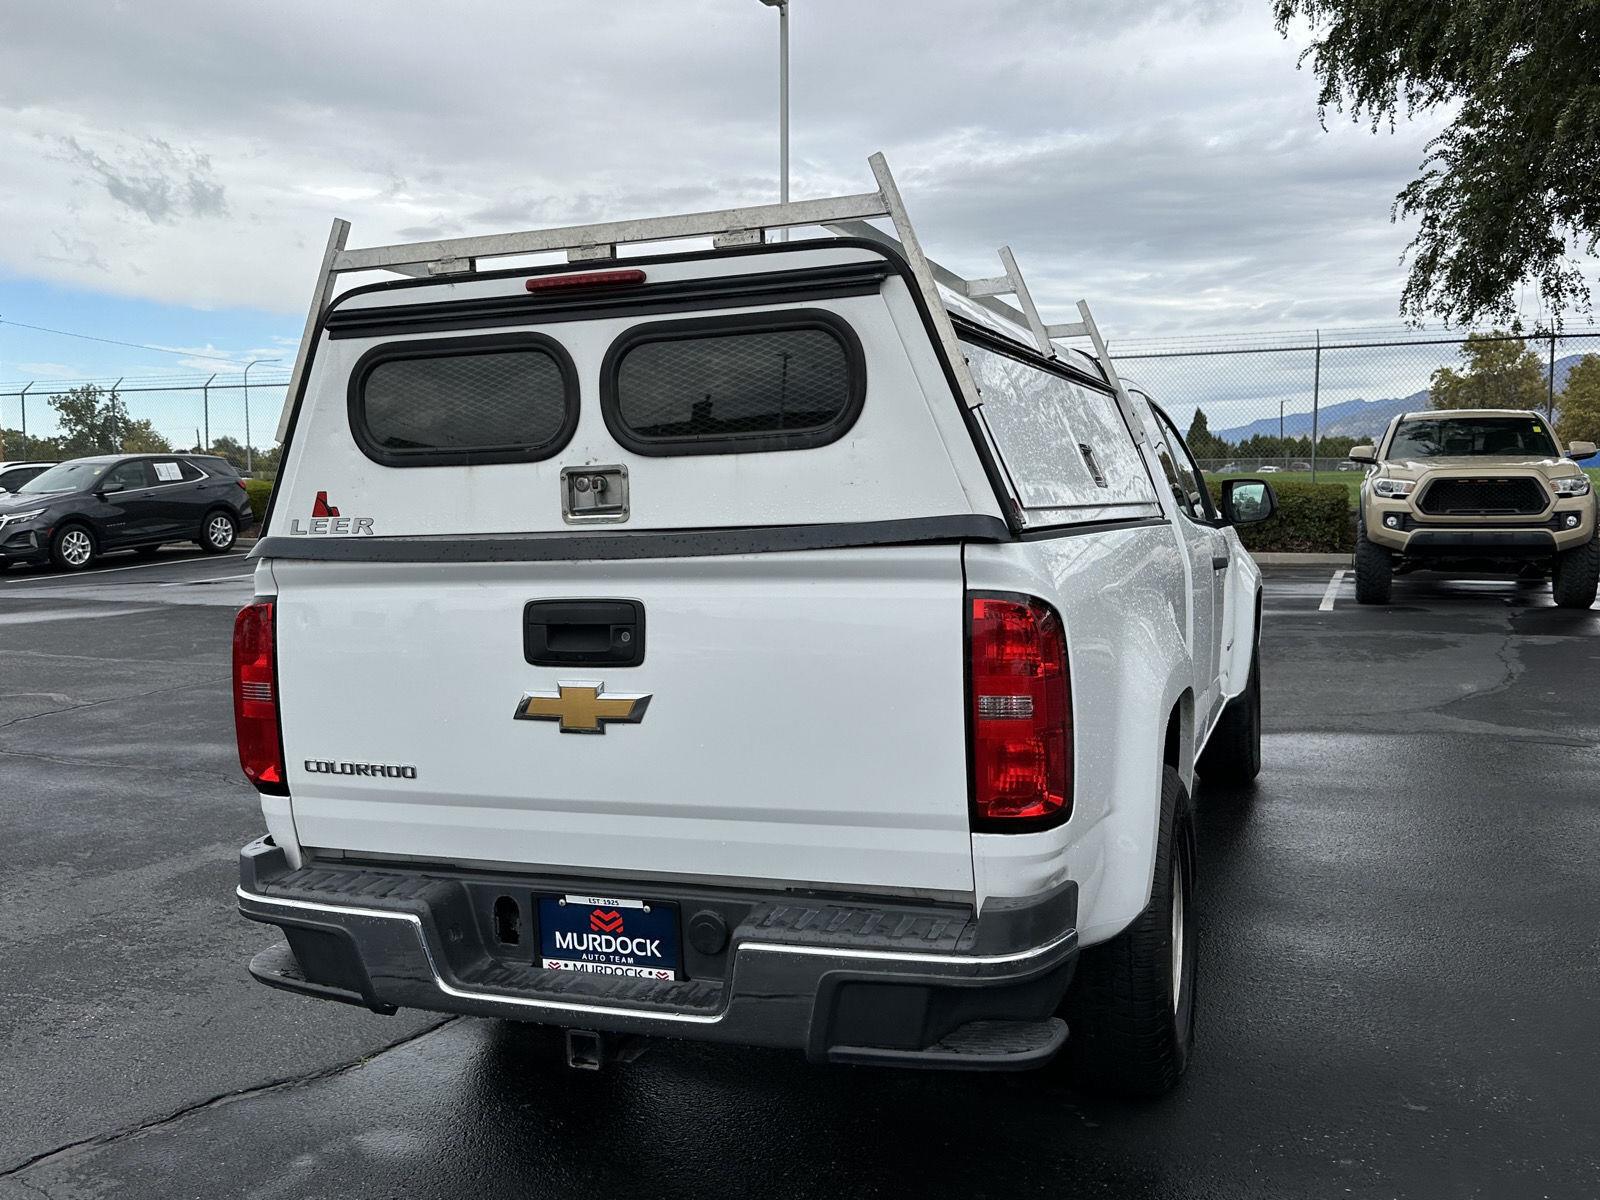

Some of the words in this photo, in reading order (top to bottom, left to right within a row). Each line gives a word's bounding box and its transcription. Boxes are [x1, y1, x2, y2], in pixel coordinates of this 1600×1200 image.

[290, 517, 375, 536] LEER
[303, 759, 418, 779] COLORADO
[603, 898, 620, 906] 1925
[555, 931, 662, 958] MURDOCK
[581, 953, 606, 962] AUTO
[609, 955, 634, 964] TEAM
[573, 963, 644, 978] MURDOCK
